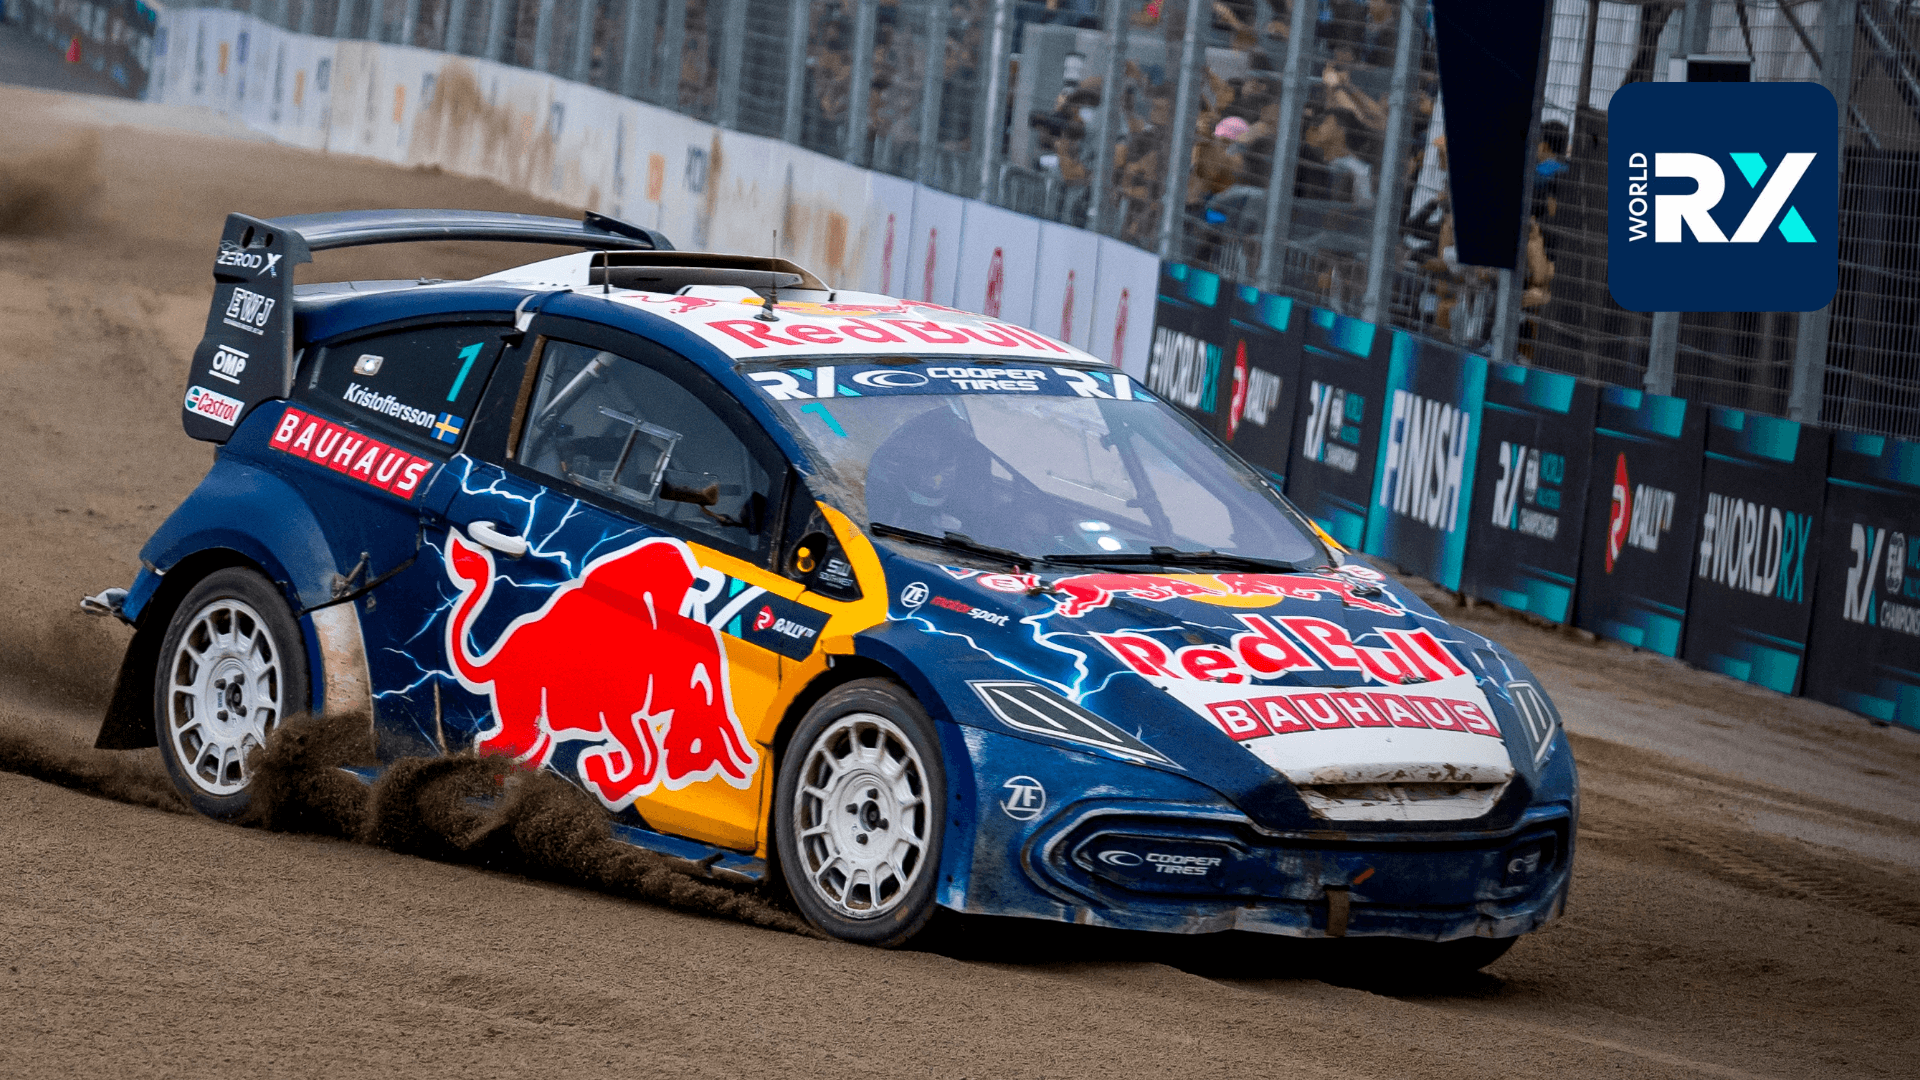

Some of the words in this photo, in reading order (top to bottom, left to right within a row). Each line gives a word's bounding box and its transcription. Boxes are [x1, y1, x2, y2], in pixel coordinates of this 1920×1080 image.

[226, 287, 276, 327] EWJ
[706, 318, 906, 349] Red
[885, 319, 1071, 354] Bull
[212, 350, 247, 378] OMP
[446, 341, 485, 402] 1
[927, 367, 1046, 380] COOPER
[748, 366, 862, 401] RX
[951, 379, 1041, 392] TIRES
[197, 392, 240, 422] Castrol
[343, 382, 437, 429] Kristoffersson
[274, 413, 433, 491] BAUHAUS
[1379, 388, 1470, 533] FINISH
[1699, 492, 1813, 604] #WORLDRX
[678, 565, 768, 639] RX
[902, 584, 928, 605] ZF
[1091, 614, 1318, 685] Red
[1275, 615, 1468, 687] Bull
[1217, 697, 1496, 736] BAUHAUS
[1002, 782, 1043, 814] ZF
[1145, 853, 1222, 867] COOPER
[1154, 864, 1209, 876] TIRES
